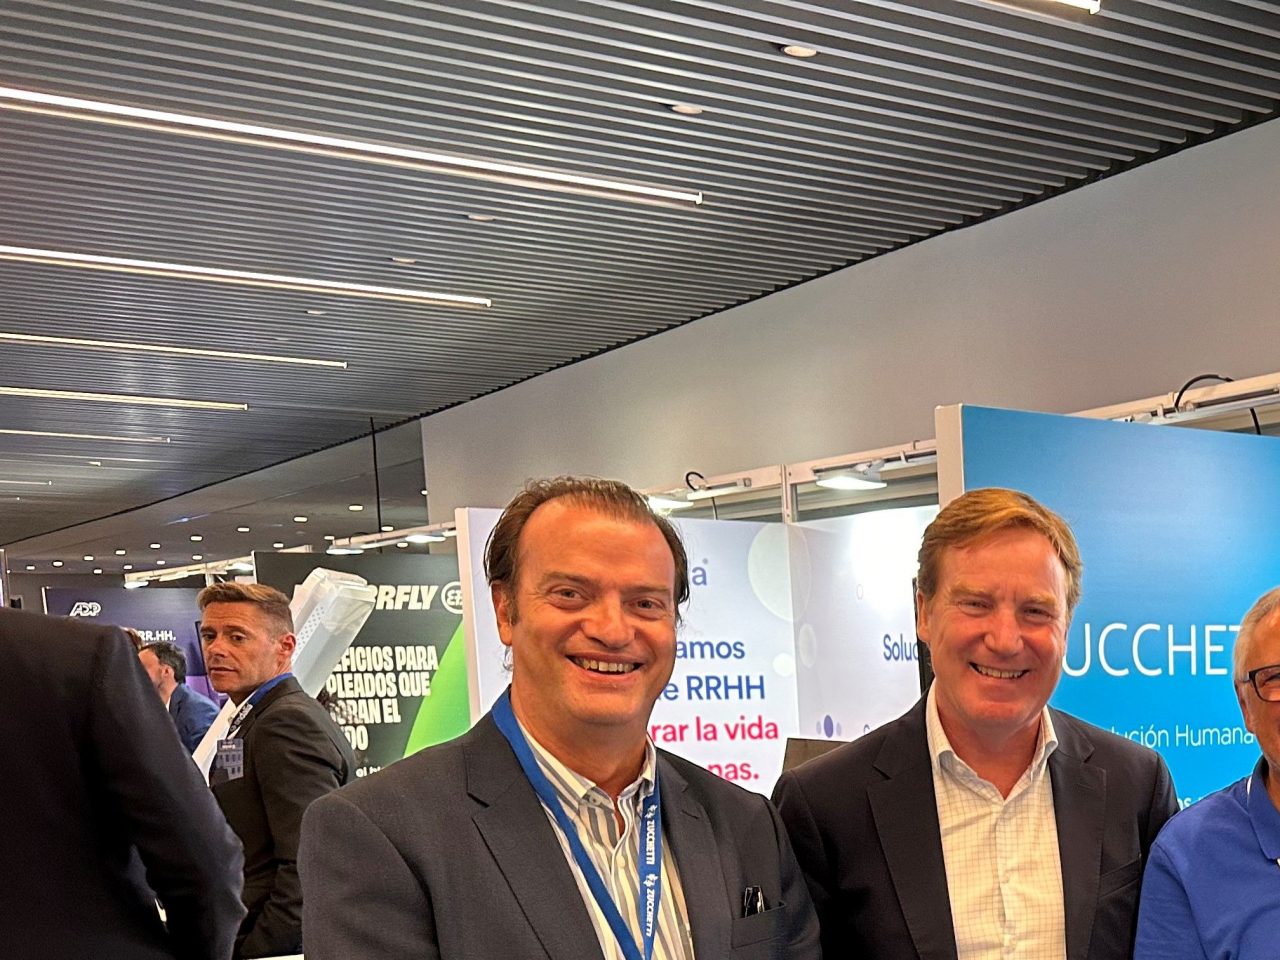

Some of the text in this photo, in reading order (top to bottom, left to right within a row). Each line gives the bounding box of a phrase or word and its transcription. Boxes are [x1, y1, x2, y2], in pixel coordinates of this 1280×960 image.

[395, 646, 439, 671] PARA
[1062, 623, 1242, 677] UCCHE
[326, 671, 431, 699] PLEADOS QUE
[686, 675, 766, 701] RRHH
[382, 698, 402, 724] EL
[696, 716, 718, 742] la
[723, 715, 779, 741] vida
